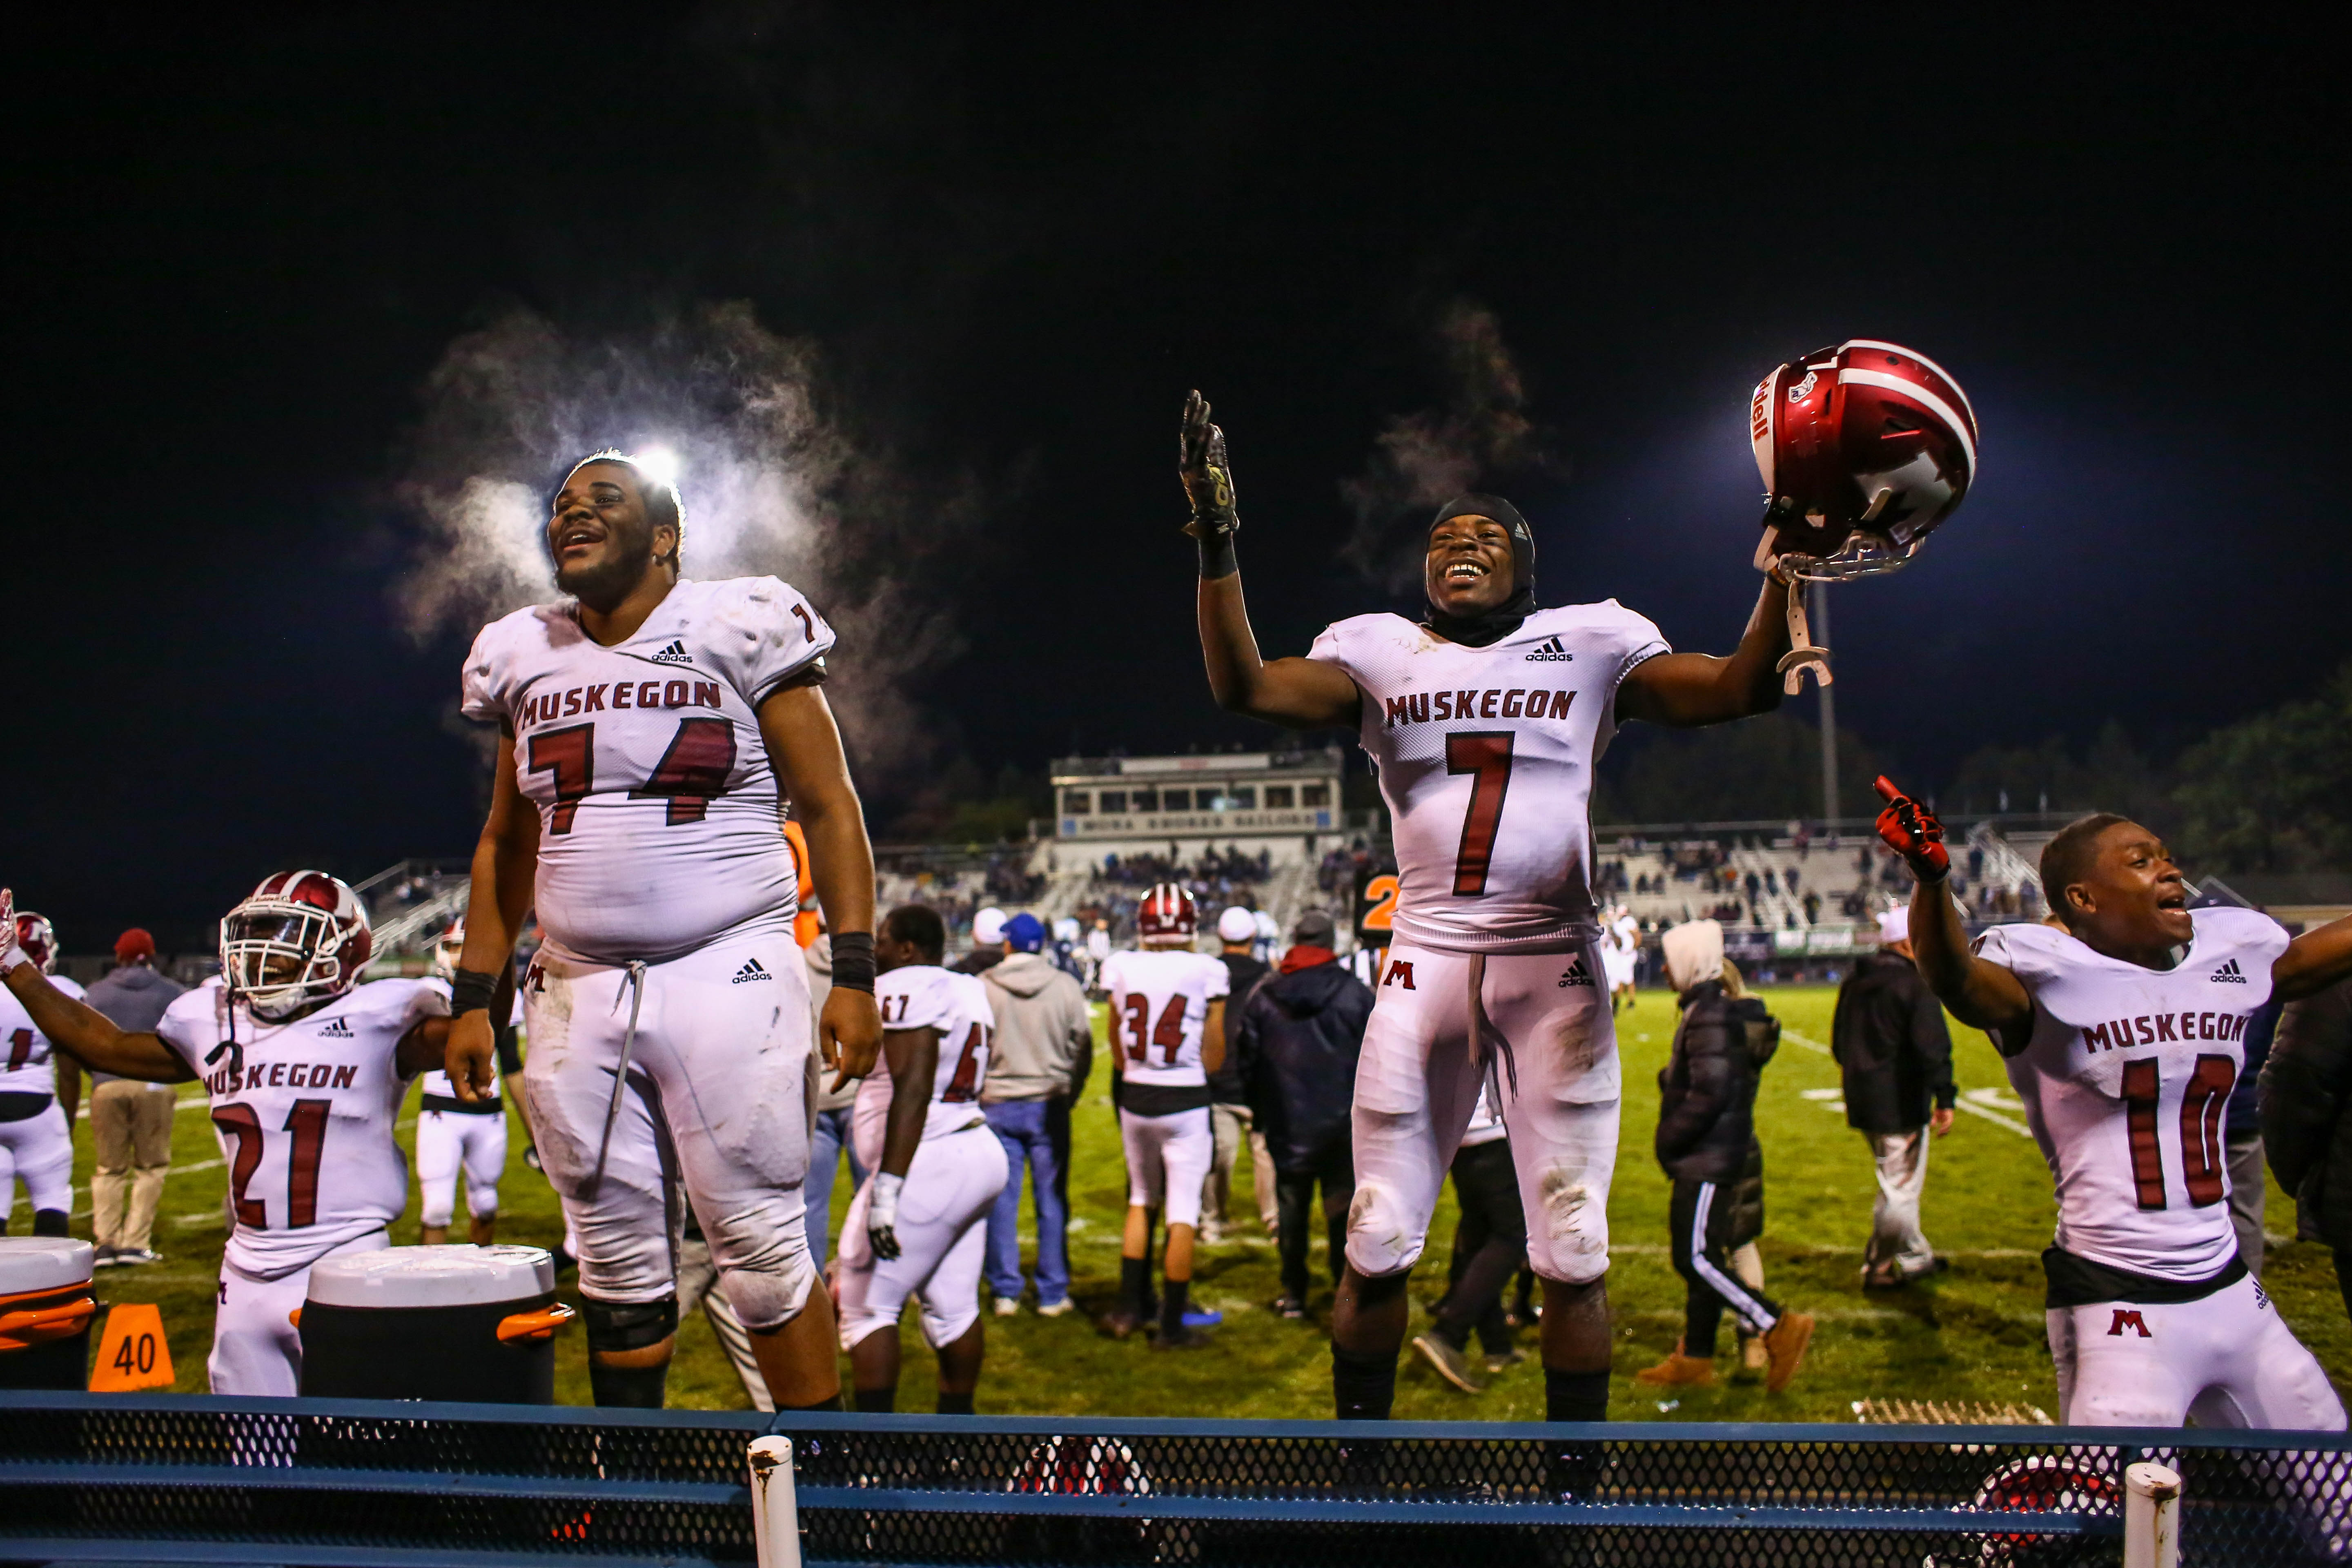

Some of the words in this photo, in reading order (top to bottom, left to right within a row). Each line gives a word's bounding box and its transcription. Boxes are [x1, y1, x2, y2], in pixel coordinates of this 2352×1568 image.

[652, 653, 693, 663] adidas
[1525, 651, 1573, 662] adidas
[522, 680, 722, 730] MUSKEGON
[1386, 688, 1578, 728] MUSKEGON
[528, 717, 735, 835] 74
[1445, 731, 1516, 897] 7
[732, 971, 773, 984] adidas
[1383, 960, 1416, 991] M
[2210, 973, 2247, 984] adidas
[1125, 993, 1189, 1064] 34
[2081, 1012, 2250, 1054] MUSKEGON
[2119, 1053, 2237, 1212] 10
[211, 1098, 332, 1230] 21
[2107, 1309, 2152, 1338] M
[114, 1332, 156, 1377] 40
